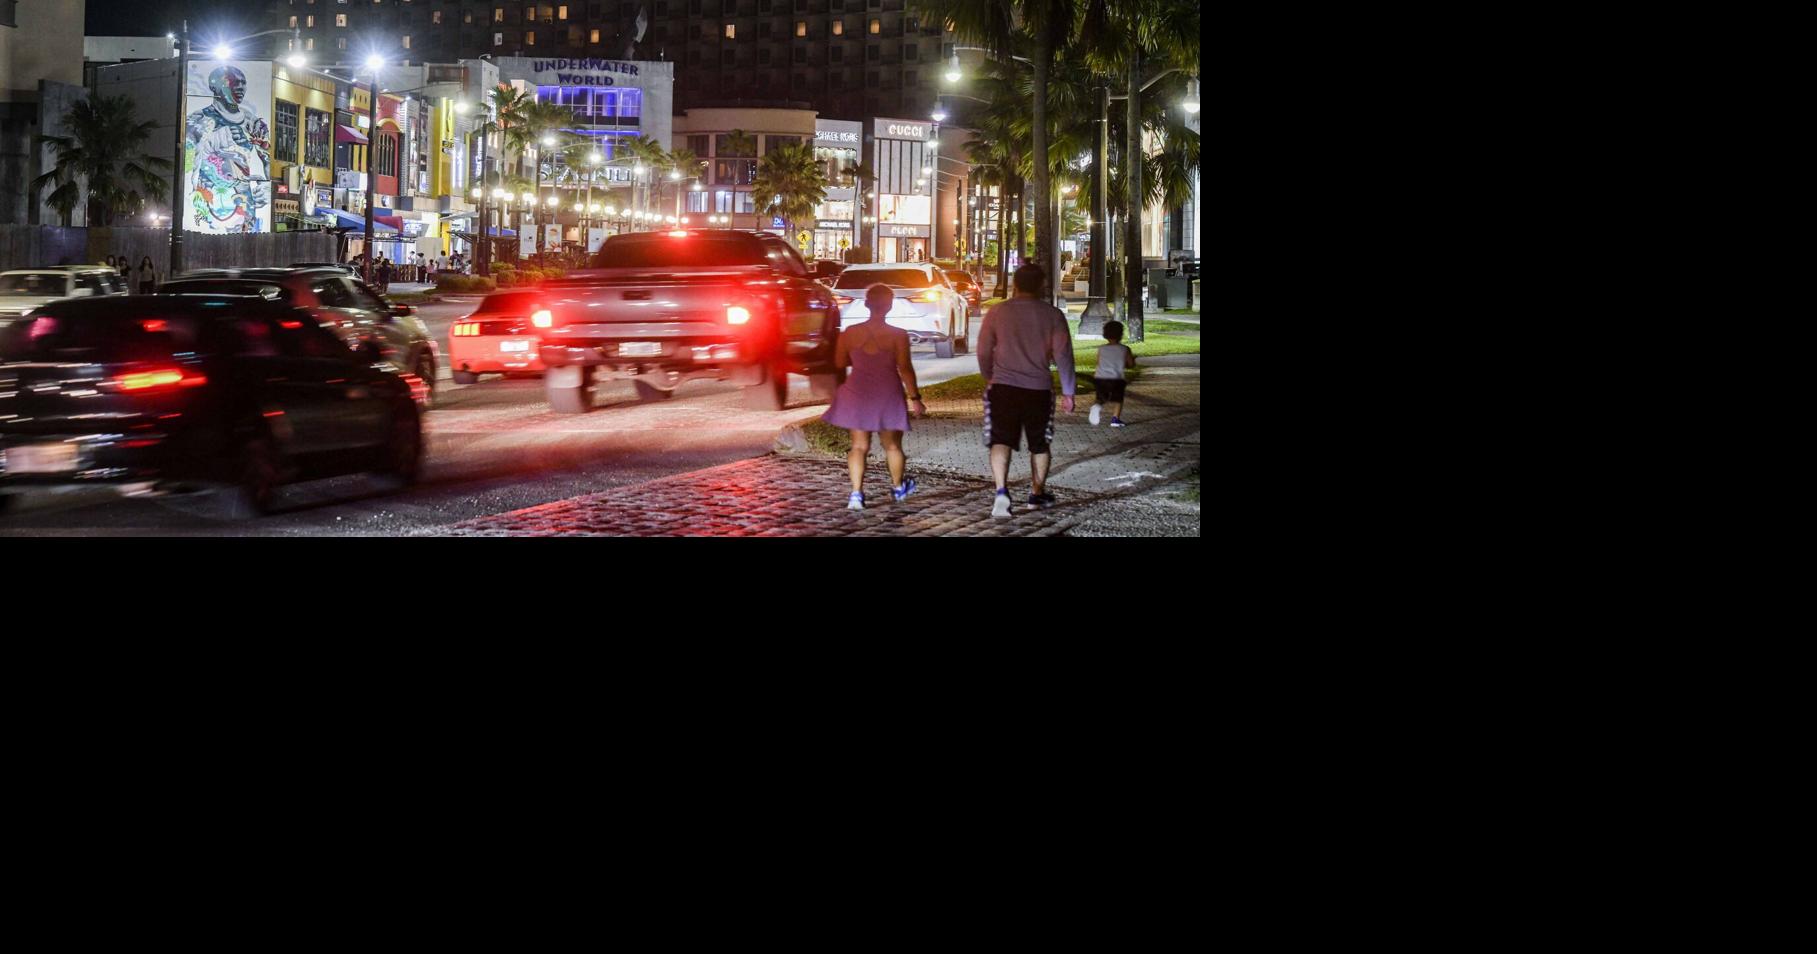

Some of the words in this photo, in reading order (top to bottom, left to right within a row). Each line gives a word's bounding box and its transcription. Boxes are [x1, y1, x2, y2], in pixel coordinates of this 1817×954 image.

[534, 58, 639, 75] UNDERWATER
[557, 74, 614, 85] WORLD
[889, 124, 922, 137] GUCCI
